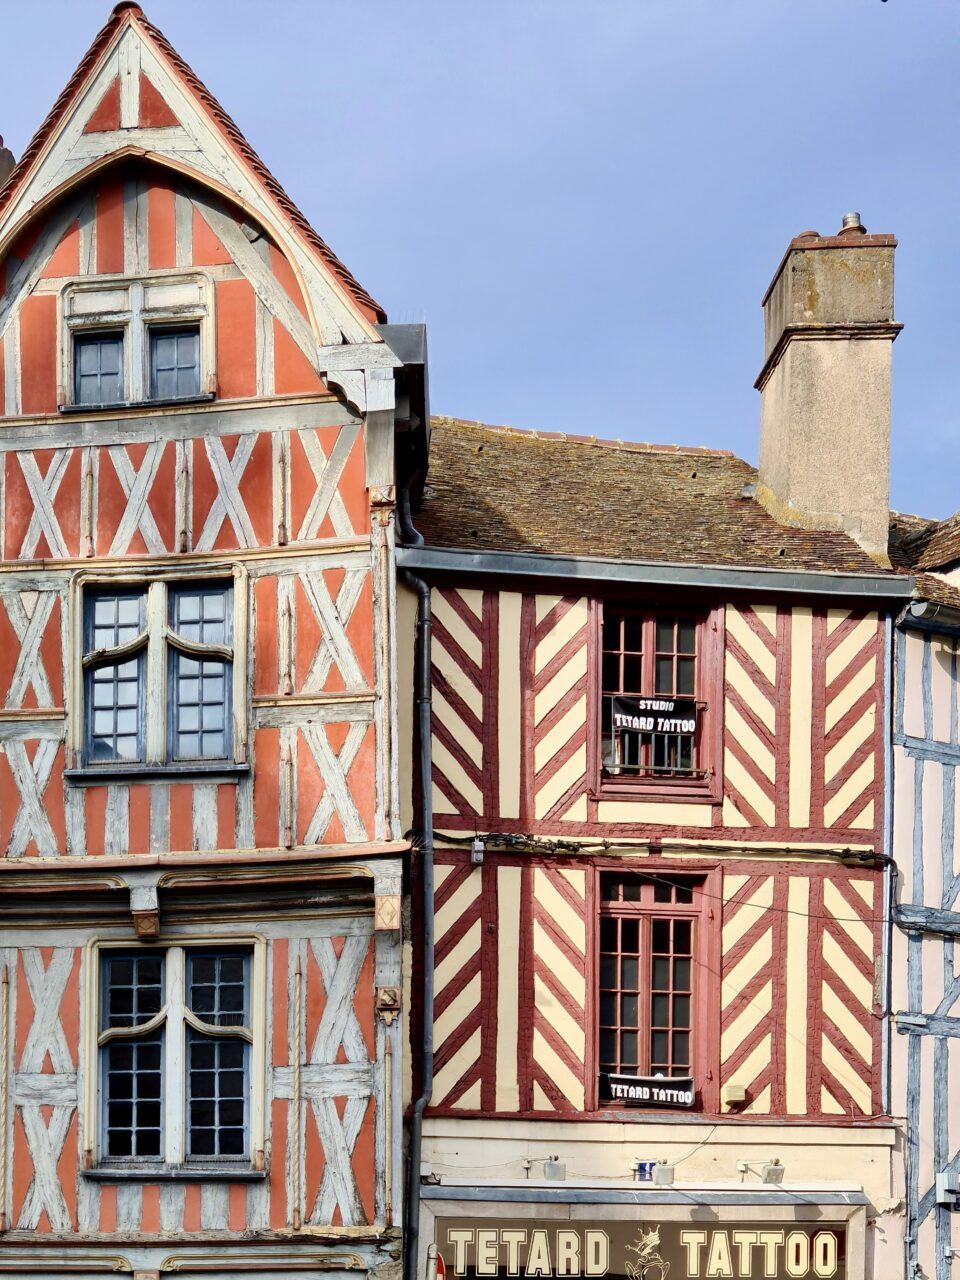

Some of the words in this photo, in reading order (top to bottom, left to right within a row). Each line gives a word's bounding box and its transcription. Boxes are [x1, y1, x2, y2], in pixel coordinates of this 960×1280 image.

[639, 699, 674, 711] STUDIO
[614, 713, 654, 730] TETARD
[657, 717, 696, 732] TATTOO
[610, 1083, 650, 1099] TETARD
[651, 1087, 692, 1103] TATTOO
[447, 1229, 610, 1278] TETARD
[680, 1230, 838, 1280] TATTOO
